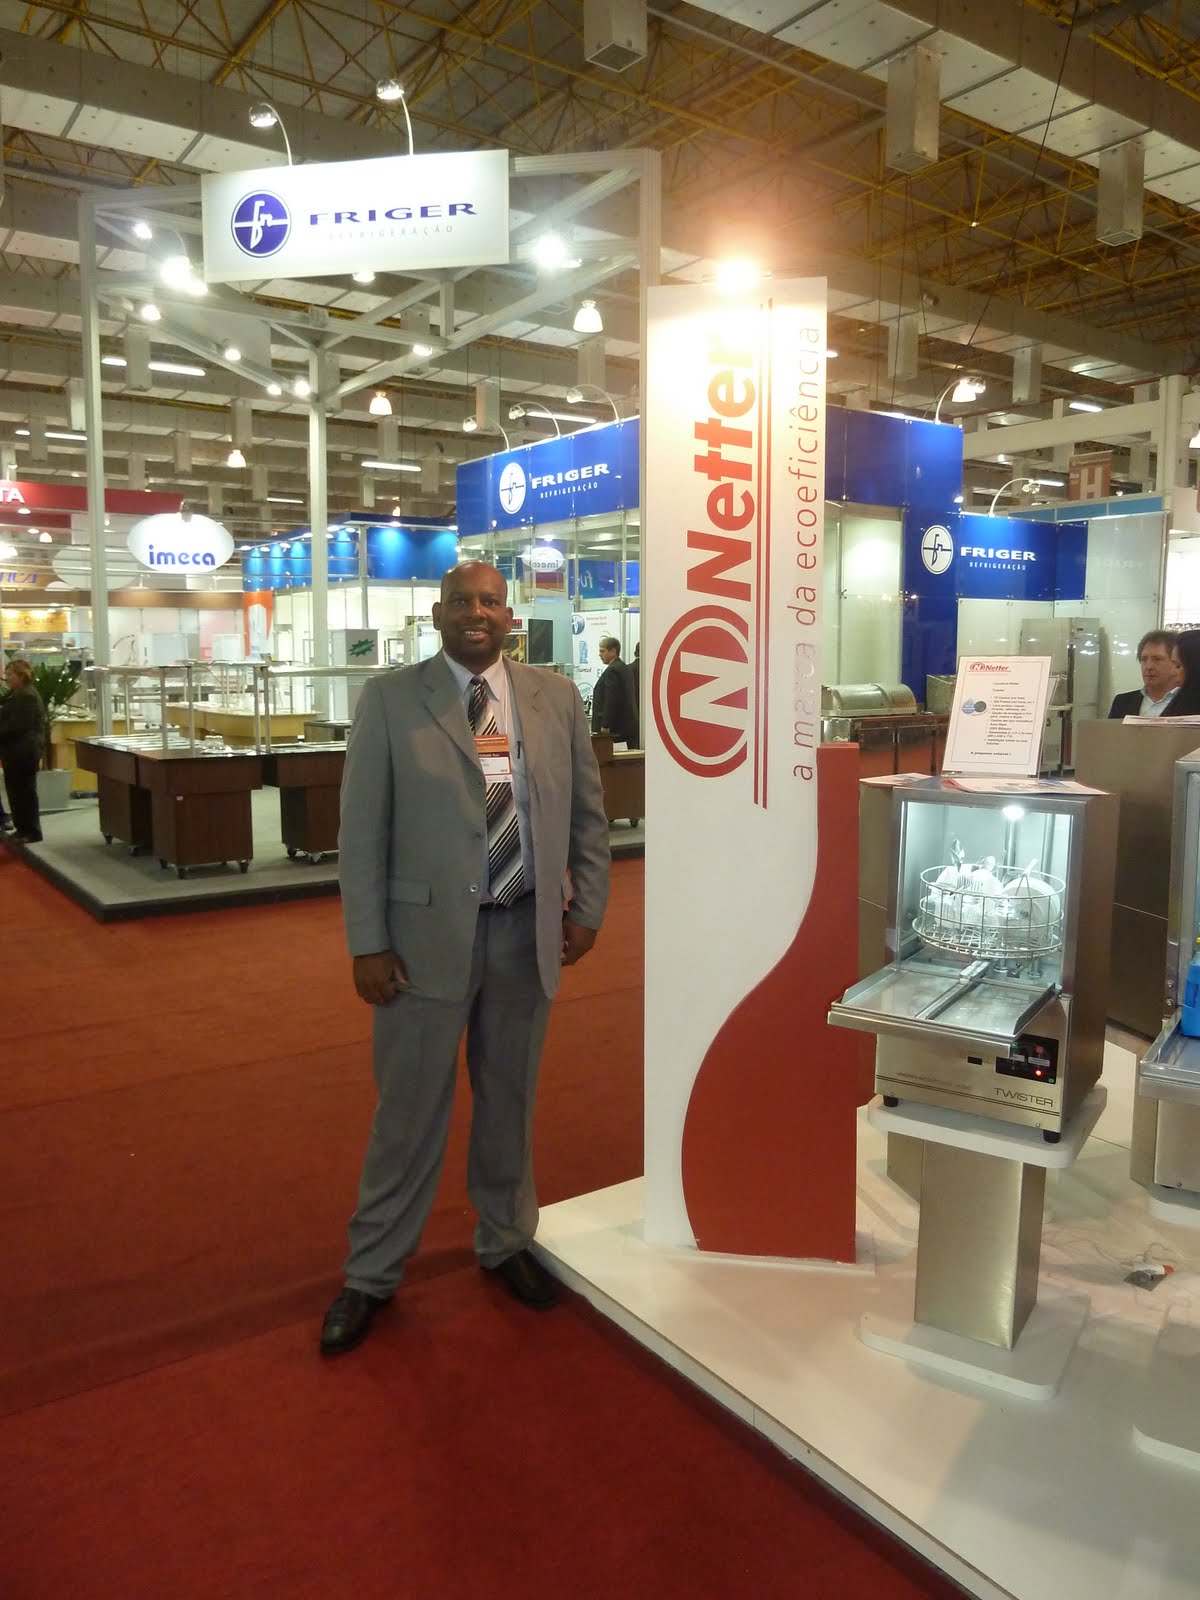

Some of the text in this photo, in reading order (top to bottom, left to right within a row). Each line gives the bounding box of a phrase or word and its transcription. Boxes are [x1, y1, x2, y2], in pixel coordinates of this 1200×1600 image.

[309, 202, 478, 226] FRIGER
[788, 327, 819, 569] ecoeficiência
[531, 463, 610, 489] FRIGER
[686, 330, 757, 602] Netter
[540, 482, 598, 499] REFRIGERAÇÃO
[1080, 466, 1103, 499] H
[149, 544, 216, 566] imeca
[960, 546, 1037, 561] FRIGER
[969, 561, 1026, 571] REFRIGERAÇÃO
[787, 586, 816, 626] da
[793, 764, 813, 781] a
[994, 1087, 1054, 1108] TWISTER
